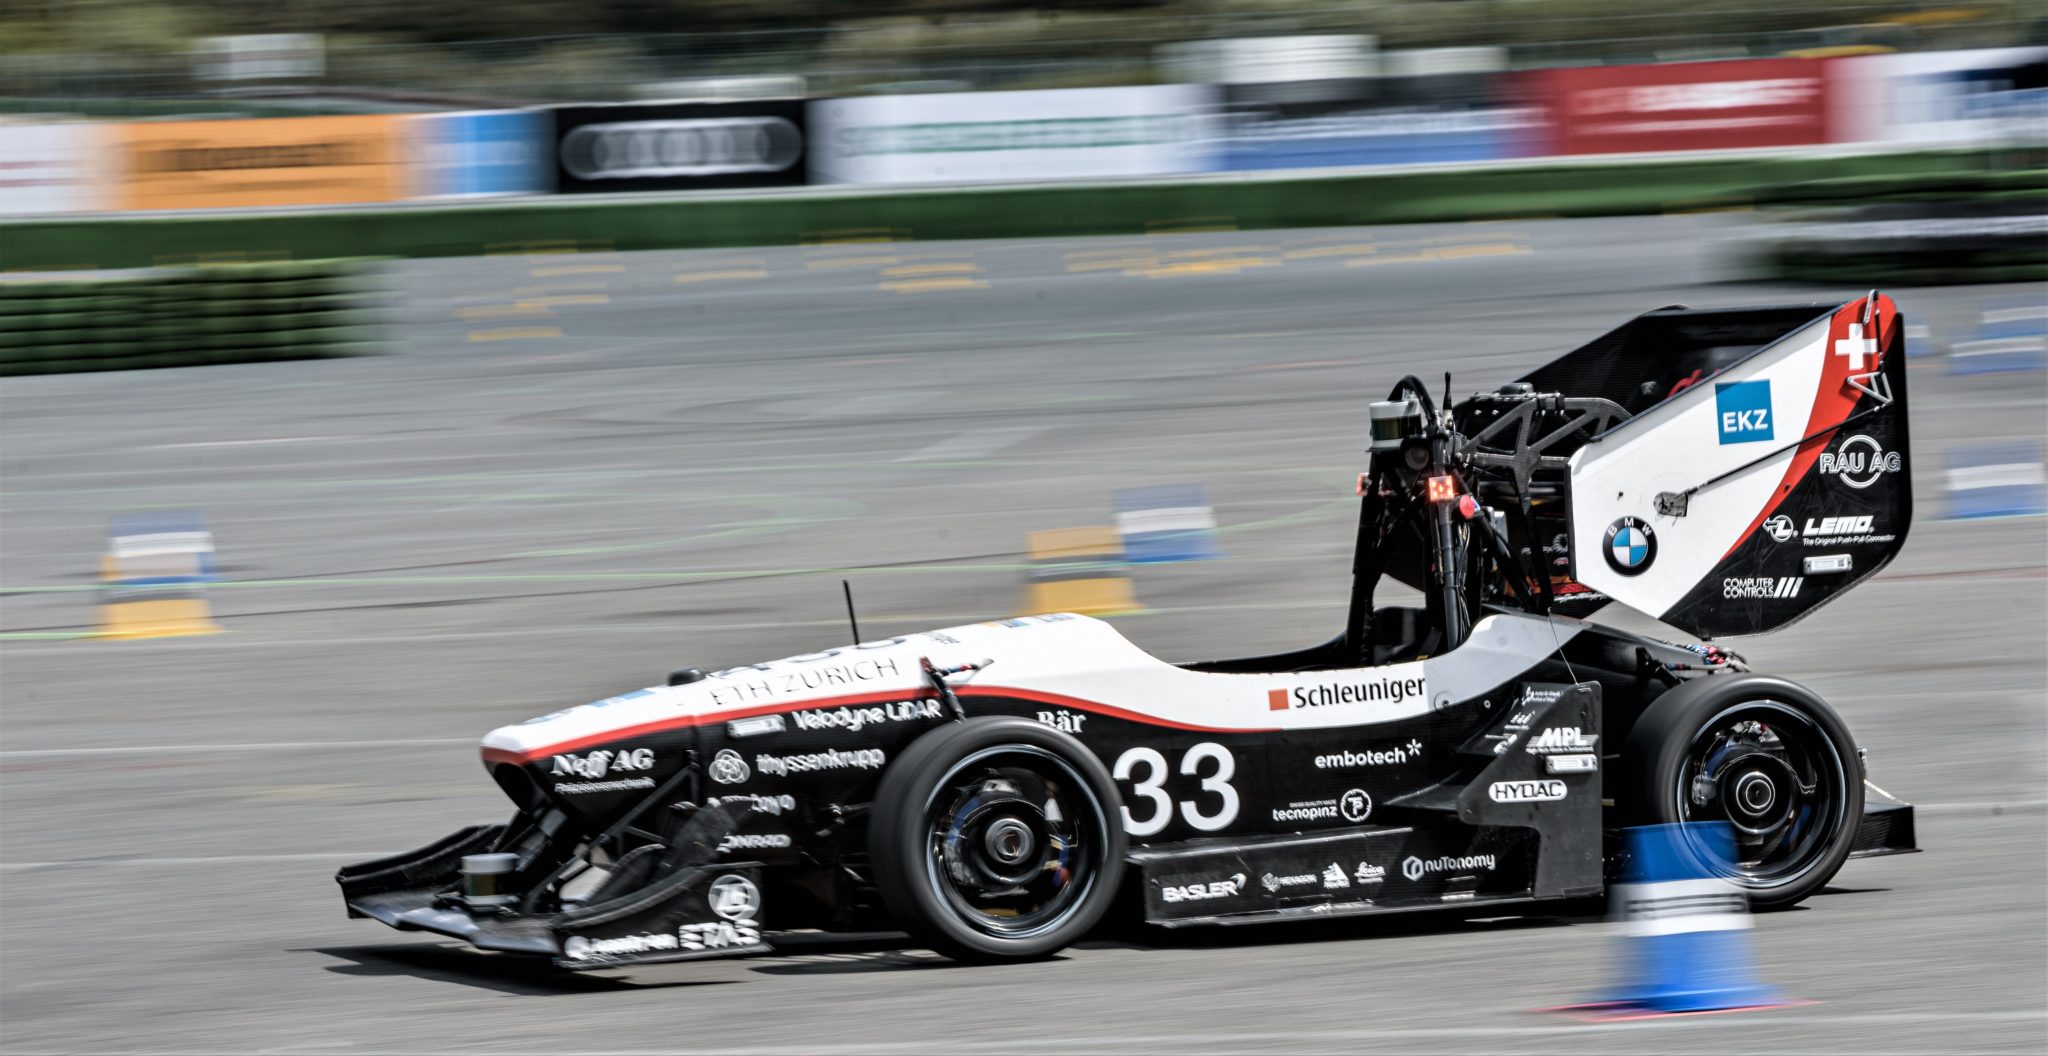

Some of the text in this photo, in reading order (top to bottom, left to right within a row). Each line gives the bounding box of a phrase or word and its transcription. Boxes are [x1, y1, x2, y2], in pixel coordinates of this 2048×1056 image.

[1723, 409, 1769, 434] EKZ
[1820, 451, 1902, 475] RAU AG
[1607, 516, 1653, 537] BMW
[1723, 577, 1774, 588] COMPUTER
[1723, 586, 1774, 599] CONTROLS
[709, 680, 774, 705] ETH
[1294, 677, 1426, 709] Schleuniger
[791, 706, 887, 732] Velodyne
[1036, 709, 1087, 734] Bär
[1536, 726, 1588, 747] MPL
[550, 748, 657, 779] Neff AG
[757, 748, 886, 777] thyssenkrupp
[1314, 746, 1407, 769] embotech
[1112, 741, 1240, 837] 33
[1494, 782, 1563, 800] HYDAC
[1424, 853, 1496, 872] nuTonomy
[1161, 879, 1240, 903] BASLER
[678, 918, 761, 951] ETAS
